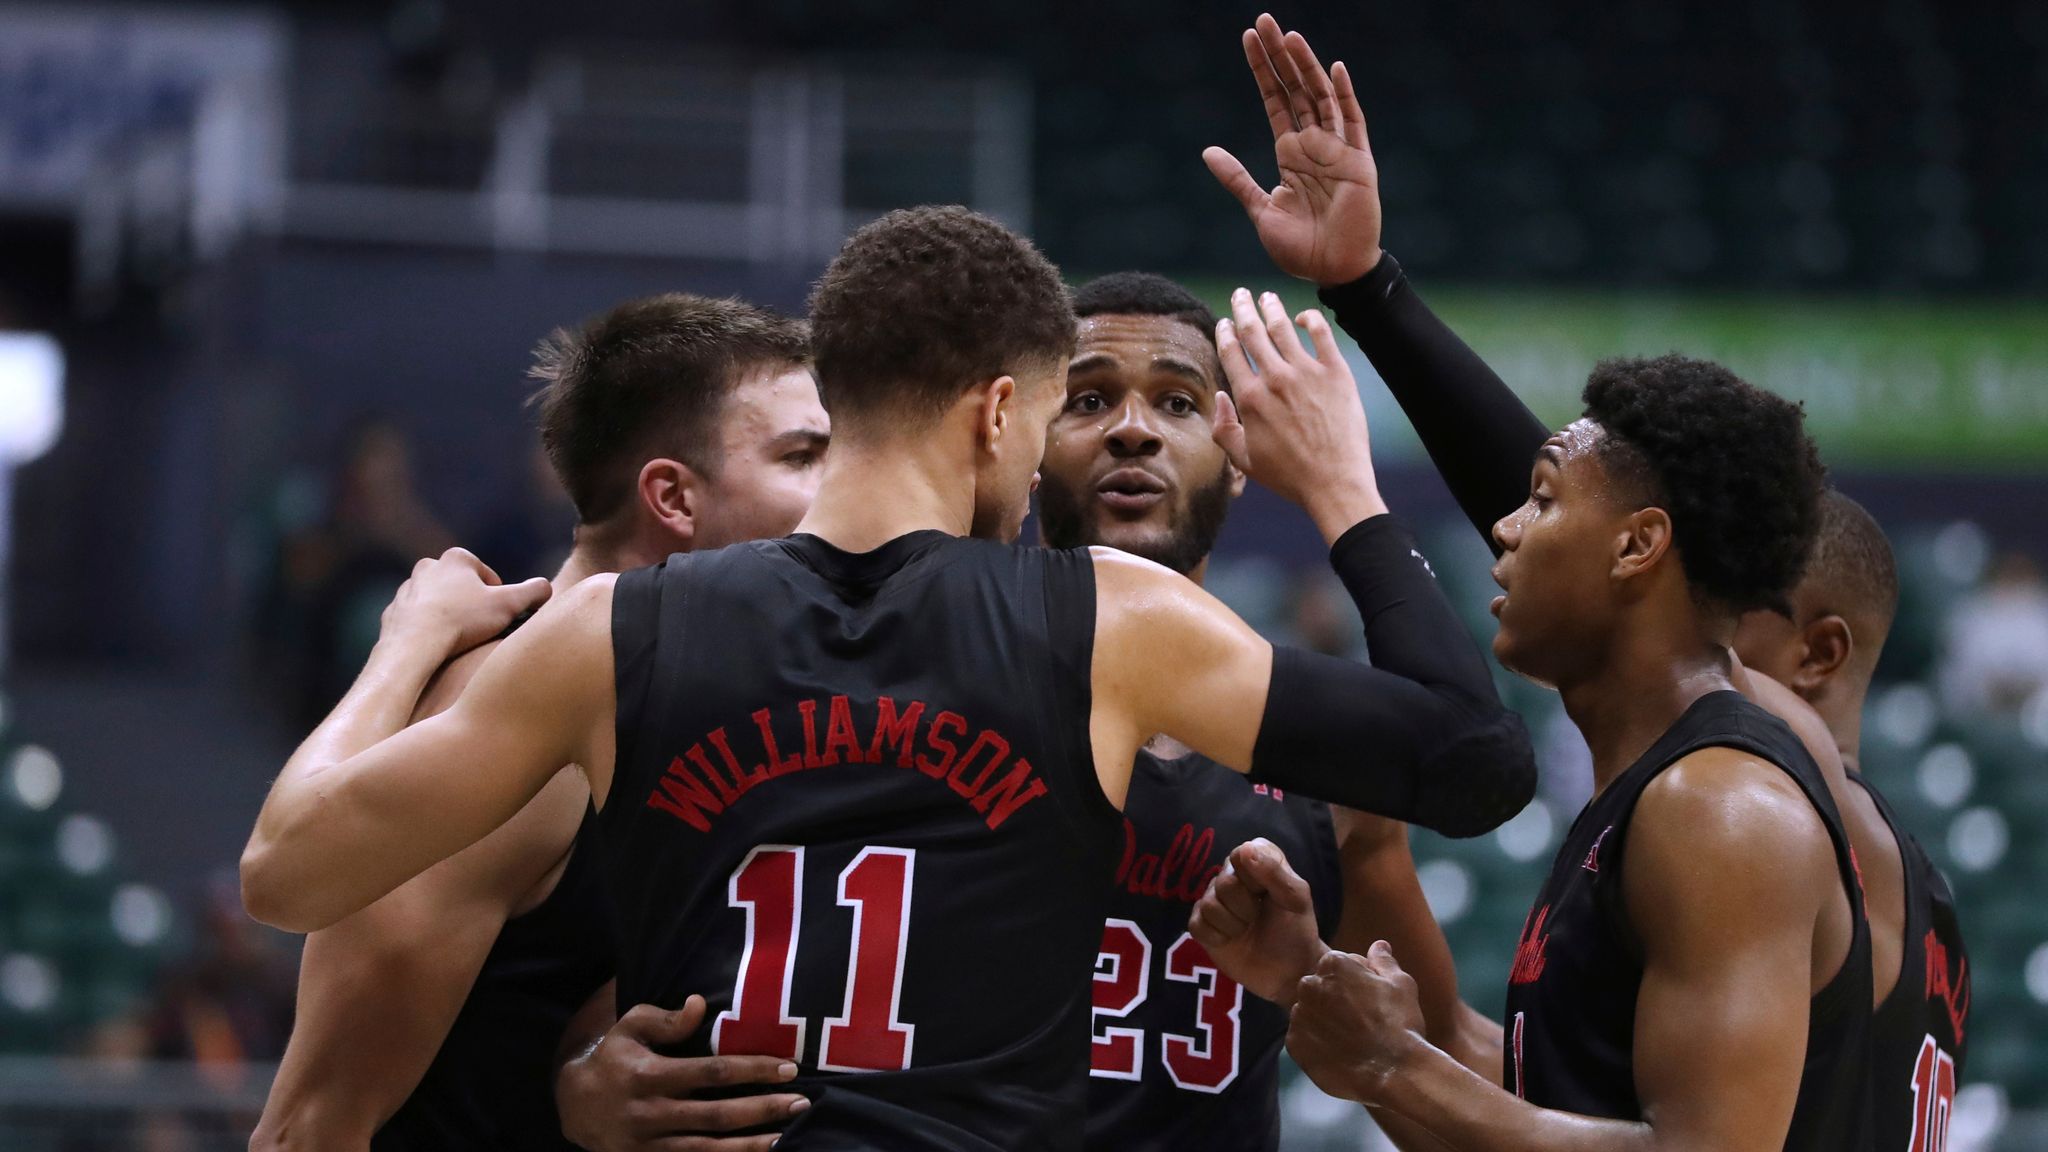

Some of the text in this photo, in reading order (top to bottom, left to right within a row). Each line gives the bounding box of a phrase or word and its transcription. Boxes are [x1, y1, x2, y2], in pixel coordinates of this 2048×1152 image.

[647, 695, 1048, 832] WILLIAMSON
[710, 844, 916, 1073] 11
[1090, 917, 1244, 1095] 23
